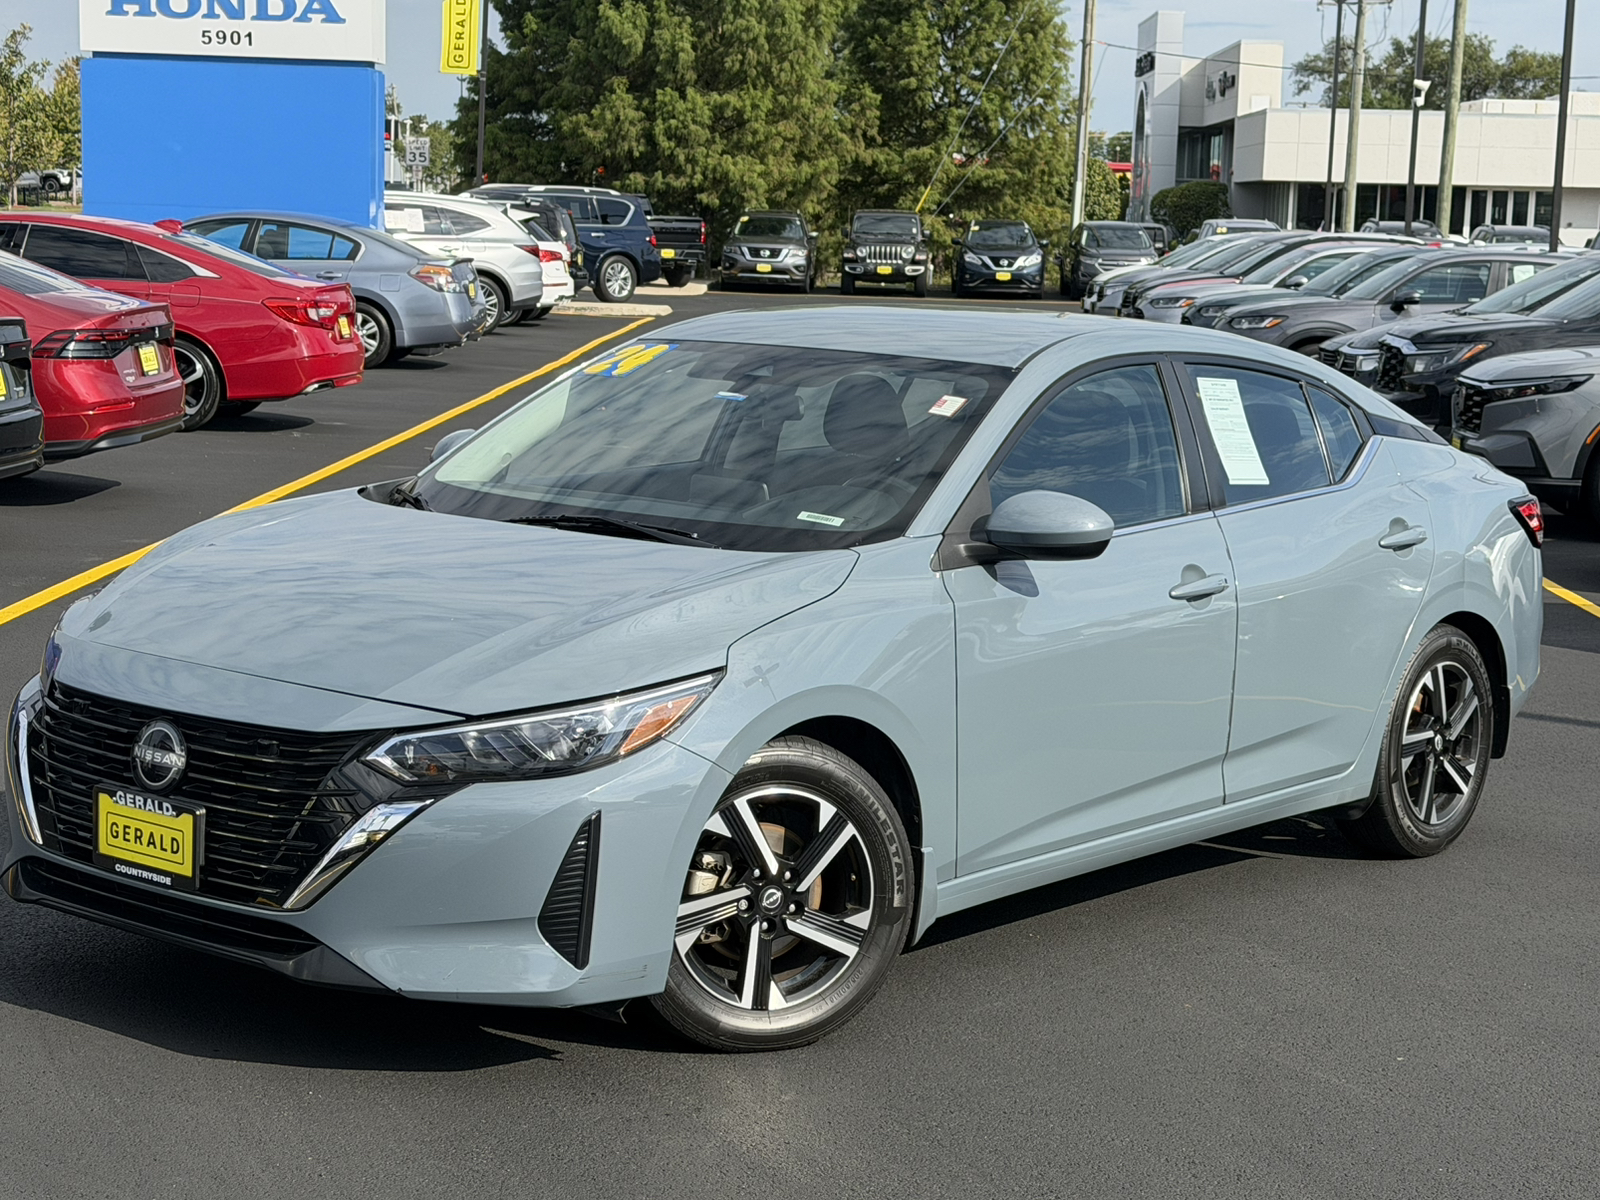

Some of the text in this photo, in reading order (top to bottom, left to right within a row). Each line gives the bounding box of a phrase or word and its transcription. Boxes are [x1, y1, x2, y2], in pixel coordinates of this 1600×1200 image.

[105, 0, 346, 24] HONDA
[201, 30, 253, 46] 5901
[453, 0, 466, 63] GERALD
[408, 151, 427, 163] 35
[133, 746, 185, 767] NISSAN
[116, 791, 172, 816] GERALD
[110, 821, 180, 855] GERALD
[859, 784, 905, 896] MILESTAR
[115, 863, 172, 886] COUNTRYSIDE
